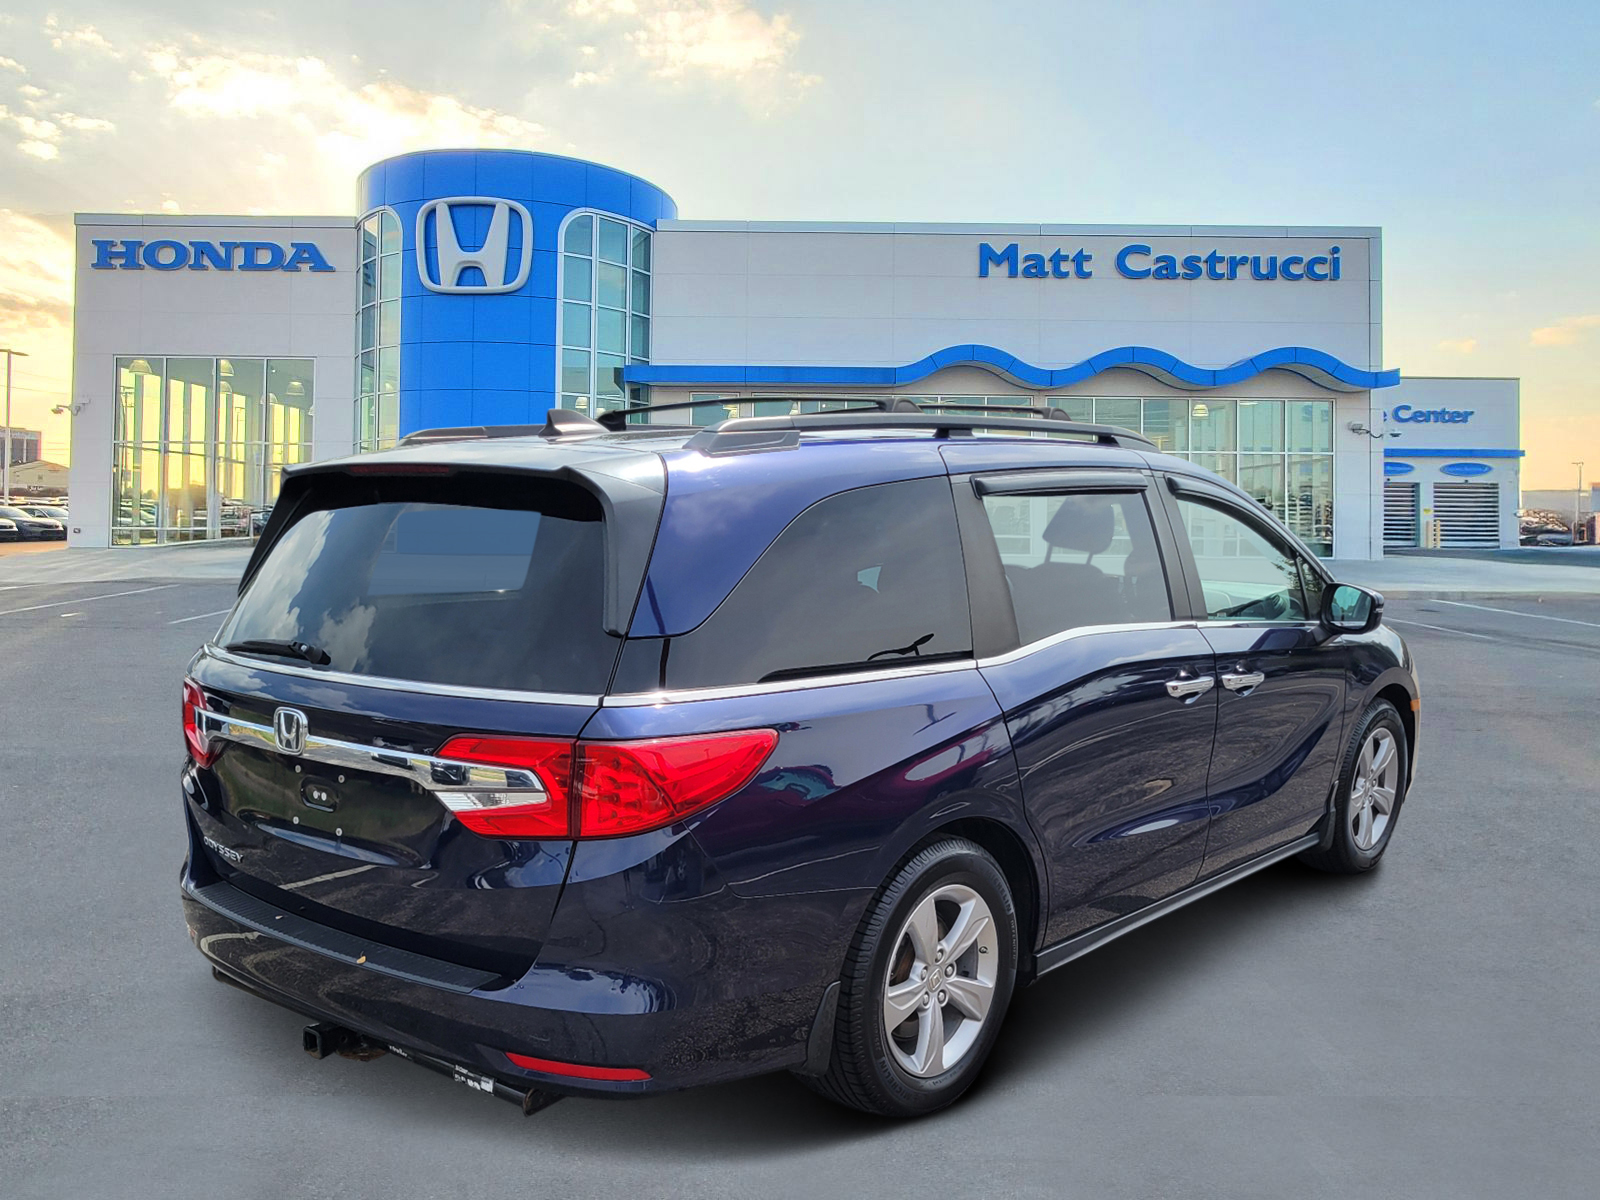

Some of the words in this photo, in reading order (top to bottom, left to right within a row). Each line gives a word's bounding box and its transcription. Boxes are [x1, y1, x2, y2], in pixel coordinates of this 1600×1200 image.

[91, 239, 336, 273] HONDA
[978, 242, 1093, 279] Matt
[1116, 244, 1342, 281] Castrucci
[1391, 404, 1475, 424] Center
[203, 836, 244, 863] ODYSSEY
